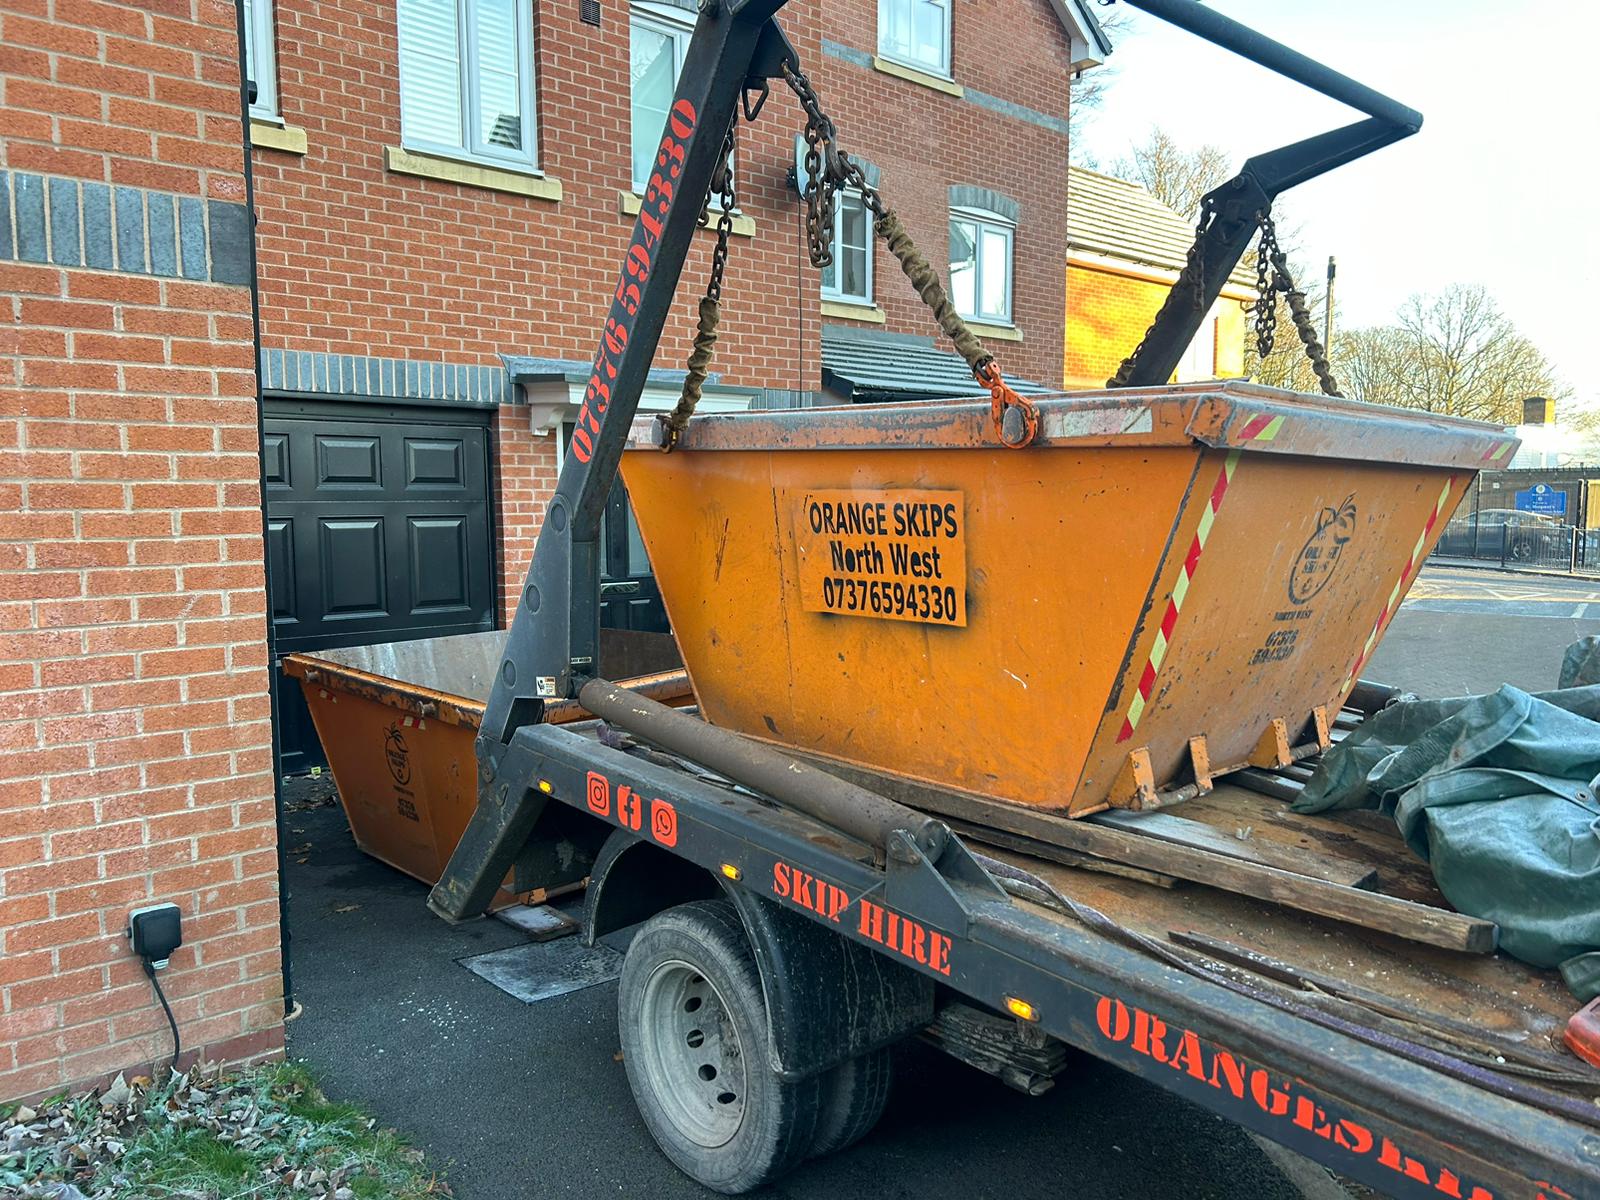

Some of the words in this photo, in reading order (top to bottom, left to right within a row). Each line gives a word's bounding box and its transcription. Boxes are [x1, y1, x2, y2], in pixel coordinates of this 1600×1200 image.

[572, 317, 628, 463] 07376
[616, 98, 697, 316] 594330
[809, 501, 888, 535] ORANGE
[893, 502, 958, 538] SKIPS
[829, 540, 885, 575] North
[888, 543, 942, 579] West
[823, 576, 957, 621] 07376594330
[773, 861, 849, 923] SKIP
[857, 898, 952, 977] HIRE
